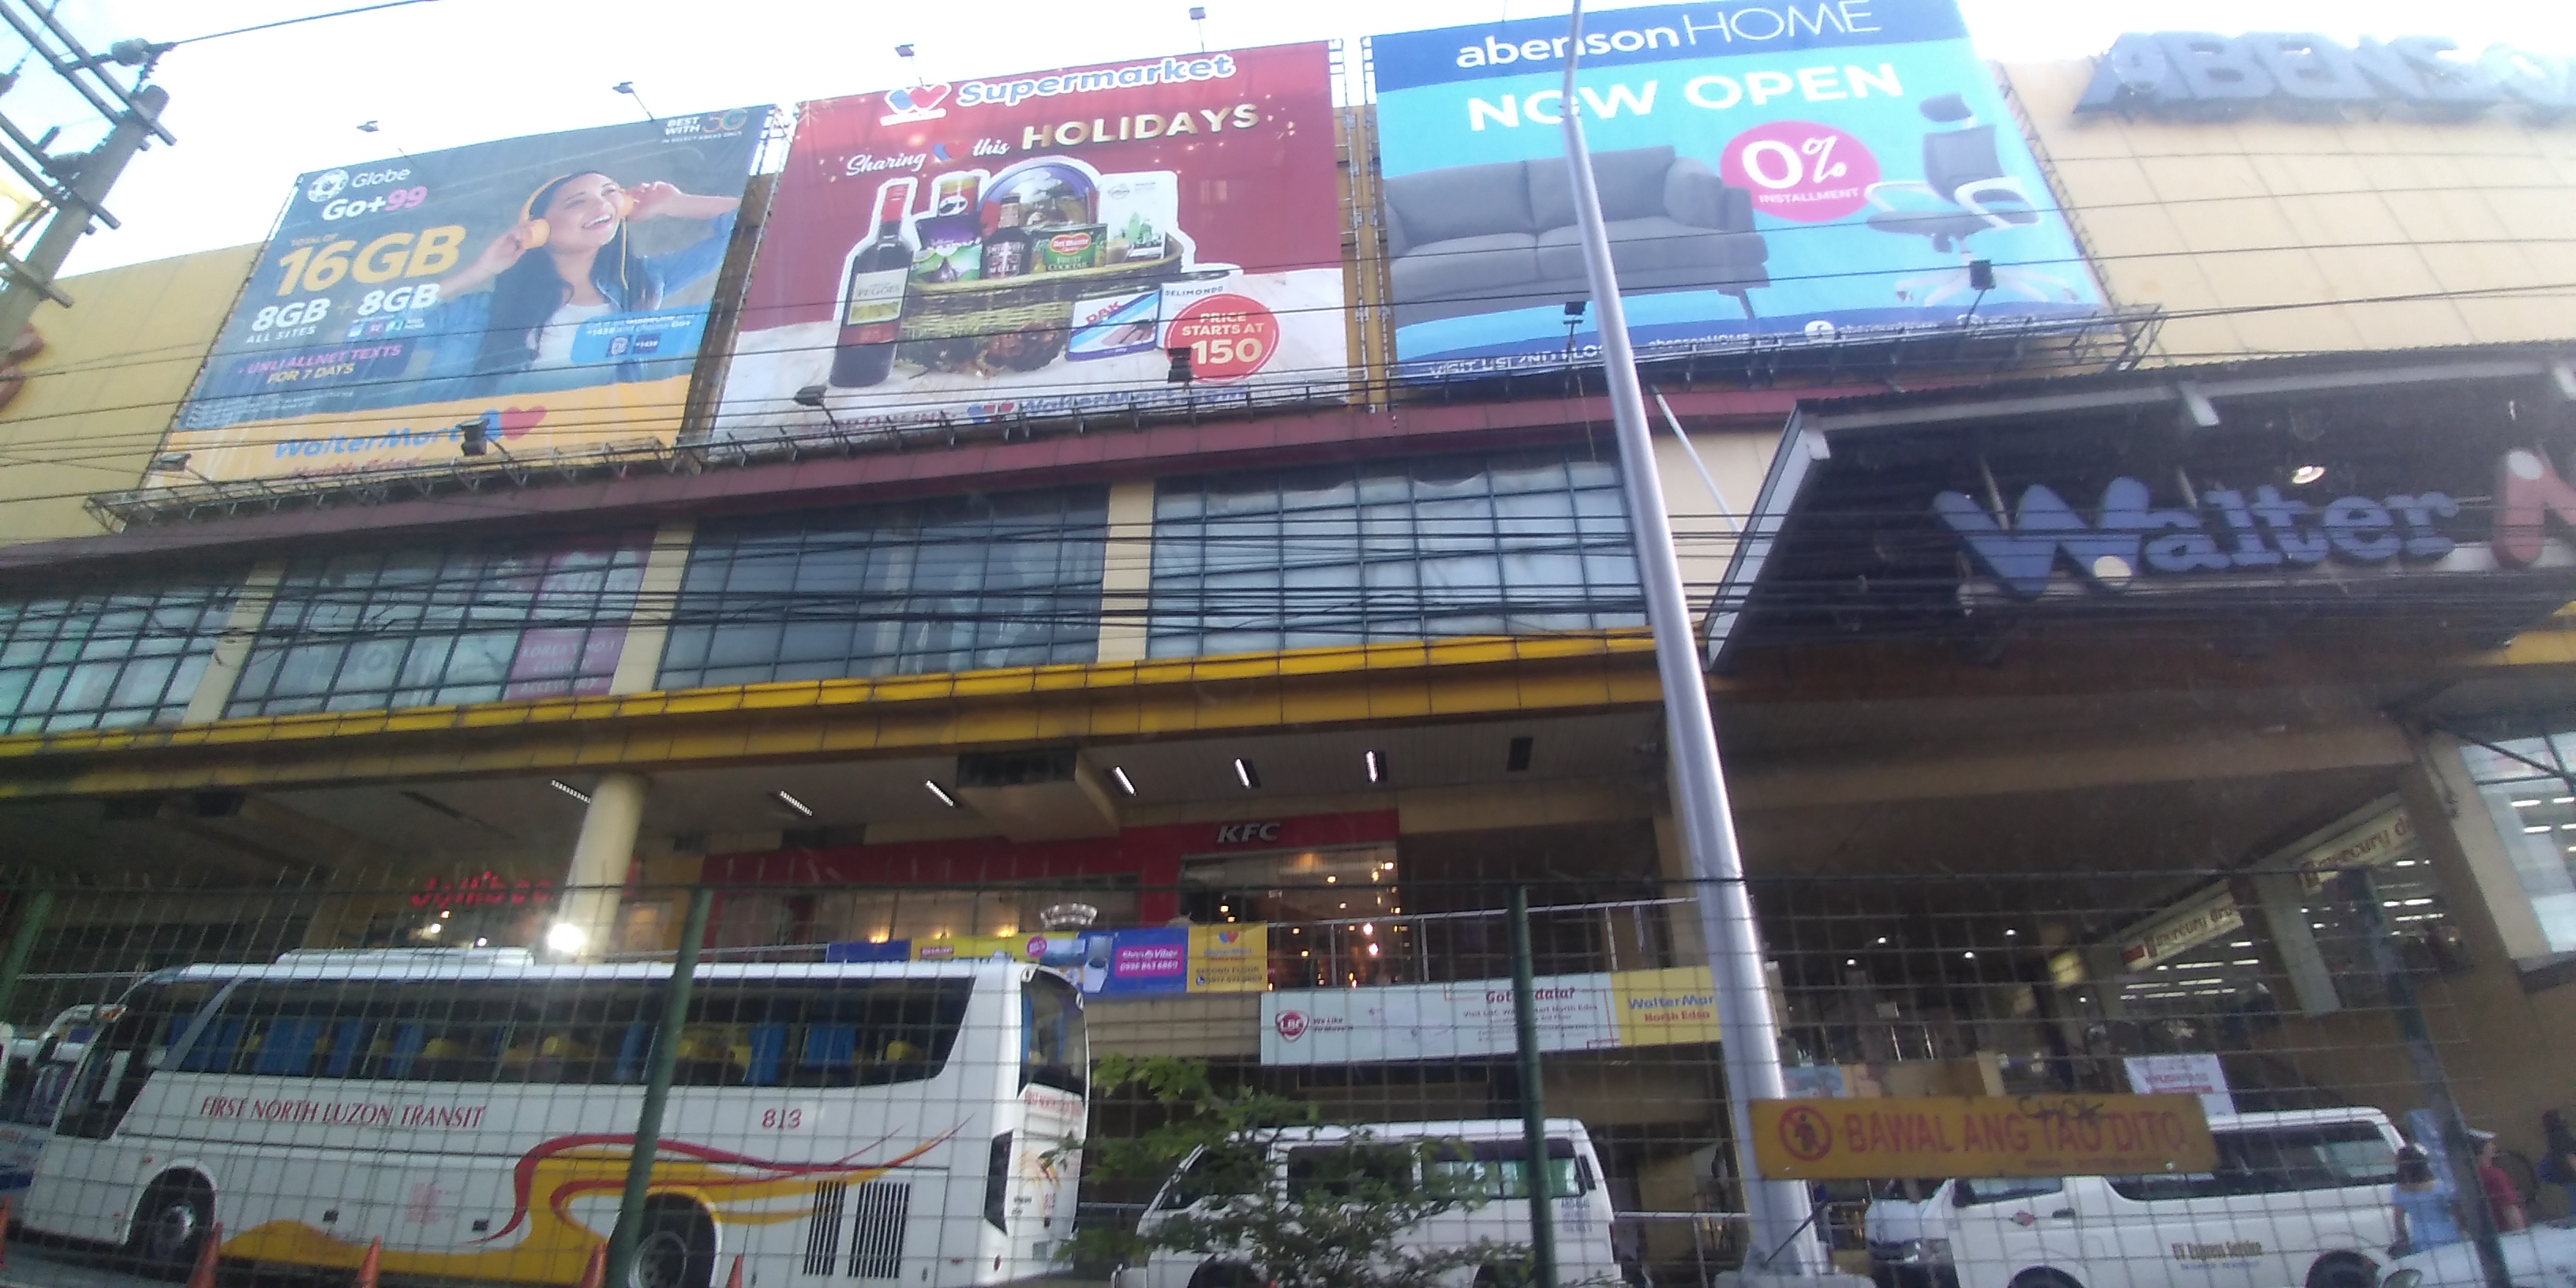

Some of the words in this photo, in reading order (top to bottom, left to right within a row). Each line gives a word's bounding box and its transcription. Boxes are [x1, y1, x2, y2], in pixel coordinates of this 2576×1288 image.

[957, 54, 1236, 106] Supermarket
[1467, 80, 1658, 132] NOW
[1684, 63, 1904, 110] OPEN
[1021, 103, 1260, 152] HOLIDAYS
[846, 152, 927, 177] Sharing
[972, 138, 1010, 156] this
[1741, 134, 1848, 190] 0%
[351, 168, 411, 189] Globe
[321, 185, 428, 221] Go+99
[1758, 186, 1859, 204] INSTALLMENT
[276, 225, 466, 297] 16GB
[1165, 285, 1224, 297] DELIMONDO
[252, 298, 331, 332] 8GB
[358, 283, 440, 316] 8GB
[1199, 312, 1248, 324] PRICE
[275, 326, 316, 341] SITES
[1181, 323, 1241, 336] STARTS
[1242, 323, 1265, 333] AT
[1191, 338, 1263, 365] 150
[267, 369, 301, 384] FOR
[301, 368, 313, 380] 7
[1934, 476, 2458, 597] Walter
[1217, 822, 1280, 844] KFC
[1486, 990, 1511, 1004] Got
[1627, 994, 1713, 1009] WalterMar
[200, 1096, 248, 1118] FIRST
[250, 1098, 320, 1122] NORTH
[321, 1102, 395, 1126] LUZON
[399, 1103, 488, 1129] TRANSIT
[762, 1107, 802, 1129] 813
[1843, 1112, 1954, 1154] BAWAL
[1962, 1111, 2030, 1153] ANG
